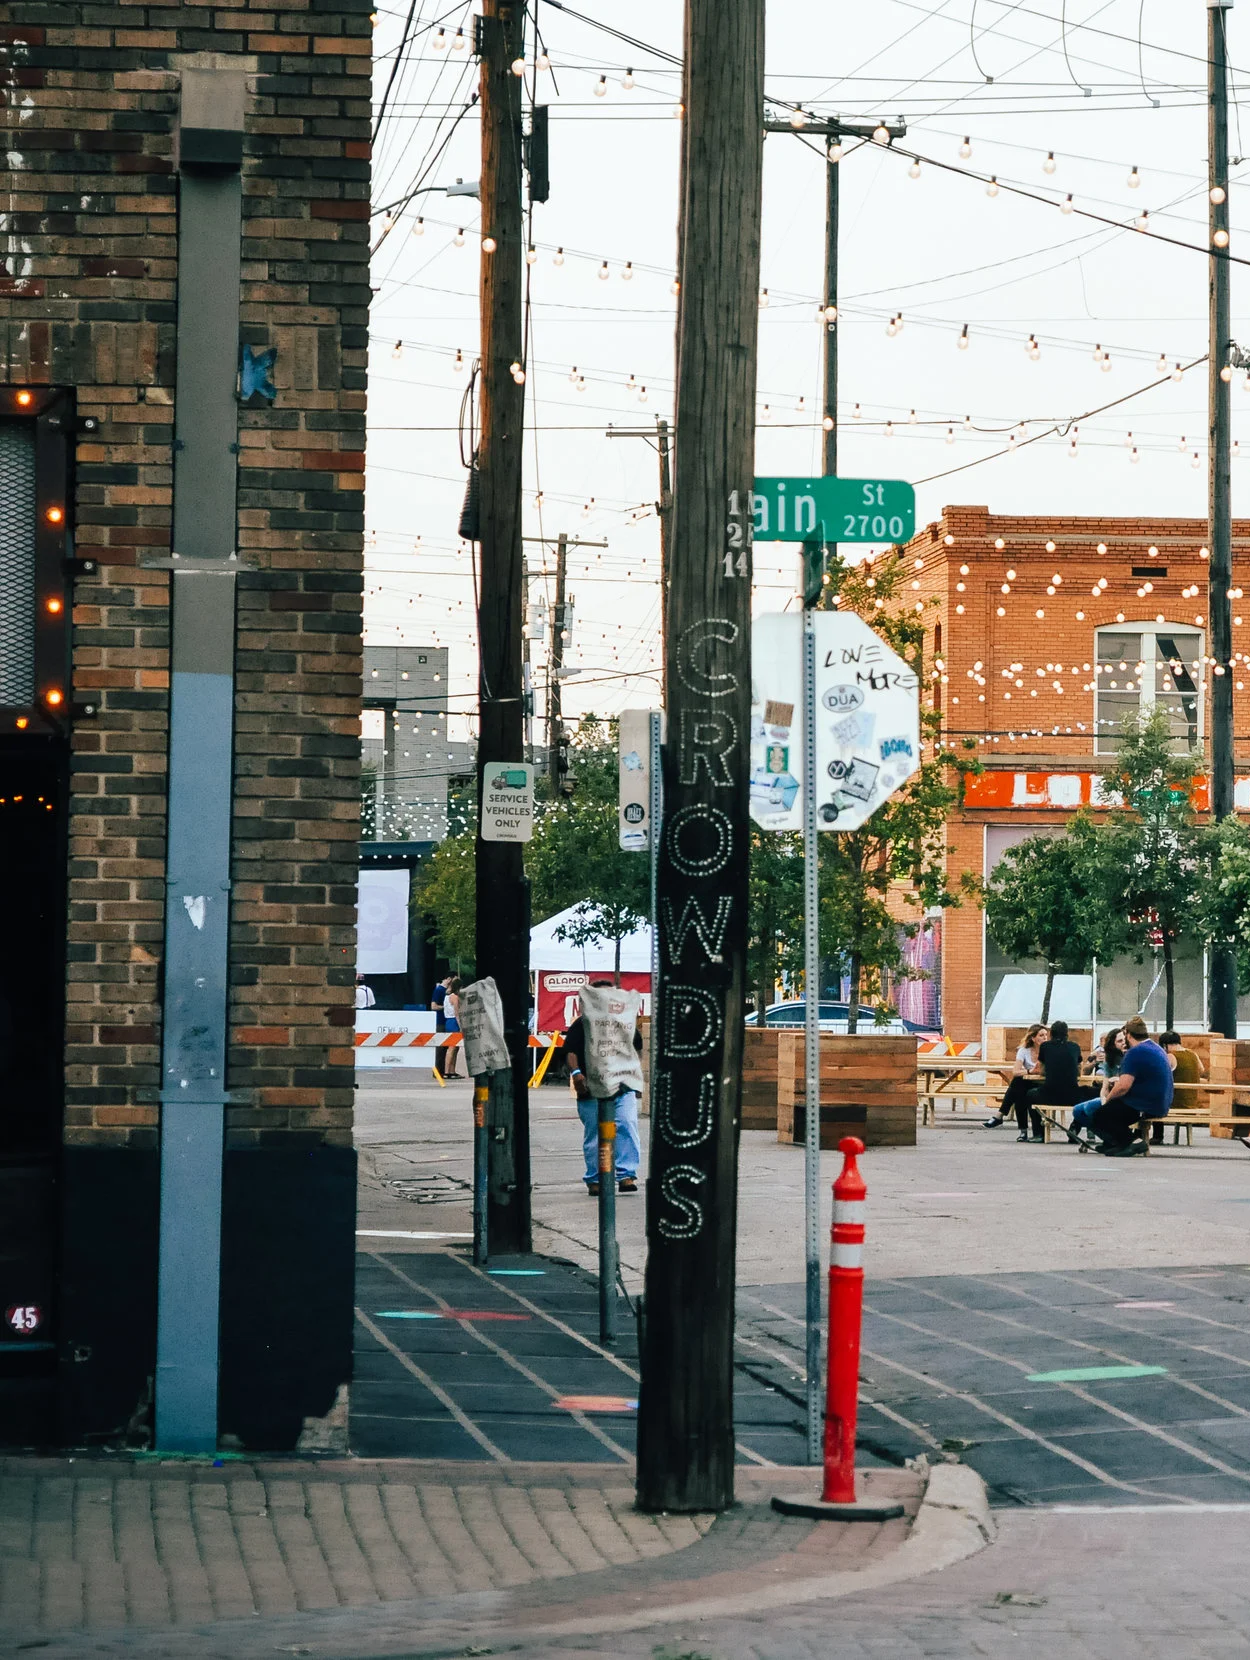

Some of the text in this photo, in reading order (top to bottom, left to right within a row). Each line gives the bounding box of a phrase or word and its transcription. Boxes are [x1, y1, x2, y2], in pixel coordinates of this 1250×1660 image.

[753, 482, 817, 533] ain
[862, 483, 885, 506] St
[843, 514, 904, 538] 2700
[722, 551, 748, 577] 14
[824, 644, 883, 668] LOVE
[856, 667, 920, 690] MORE
[828, 695, 859, 708] DUA
[489, 794, 528, 804] SERVICE
[485, 806, 530, 816] VEHICLES
[495, 819, 521, 828] ONLY
[658, 618, 740, 1239] CROWDUS
[548, 977, 585, 985] ALAMO
[11, 1307, 37, 1329] 45
